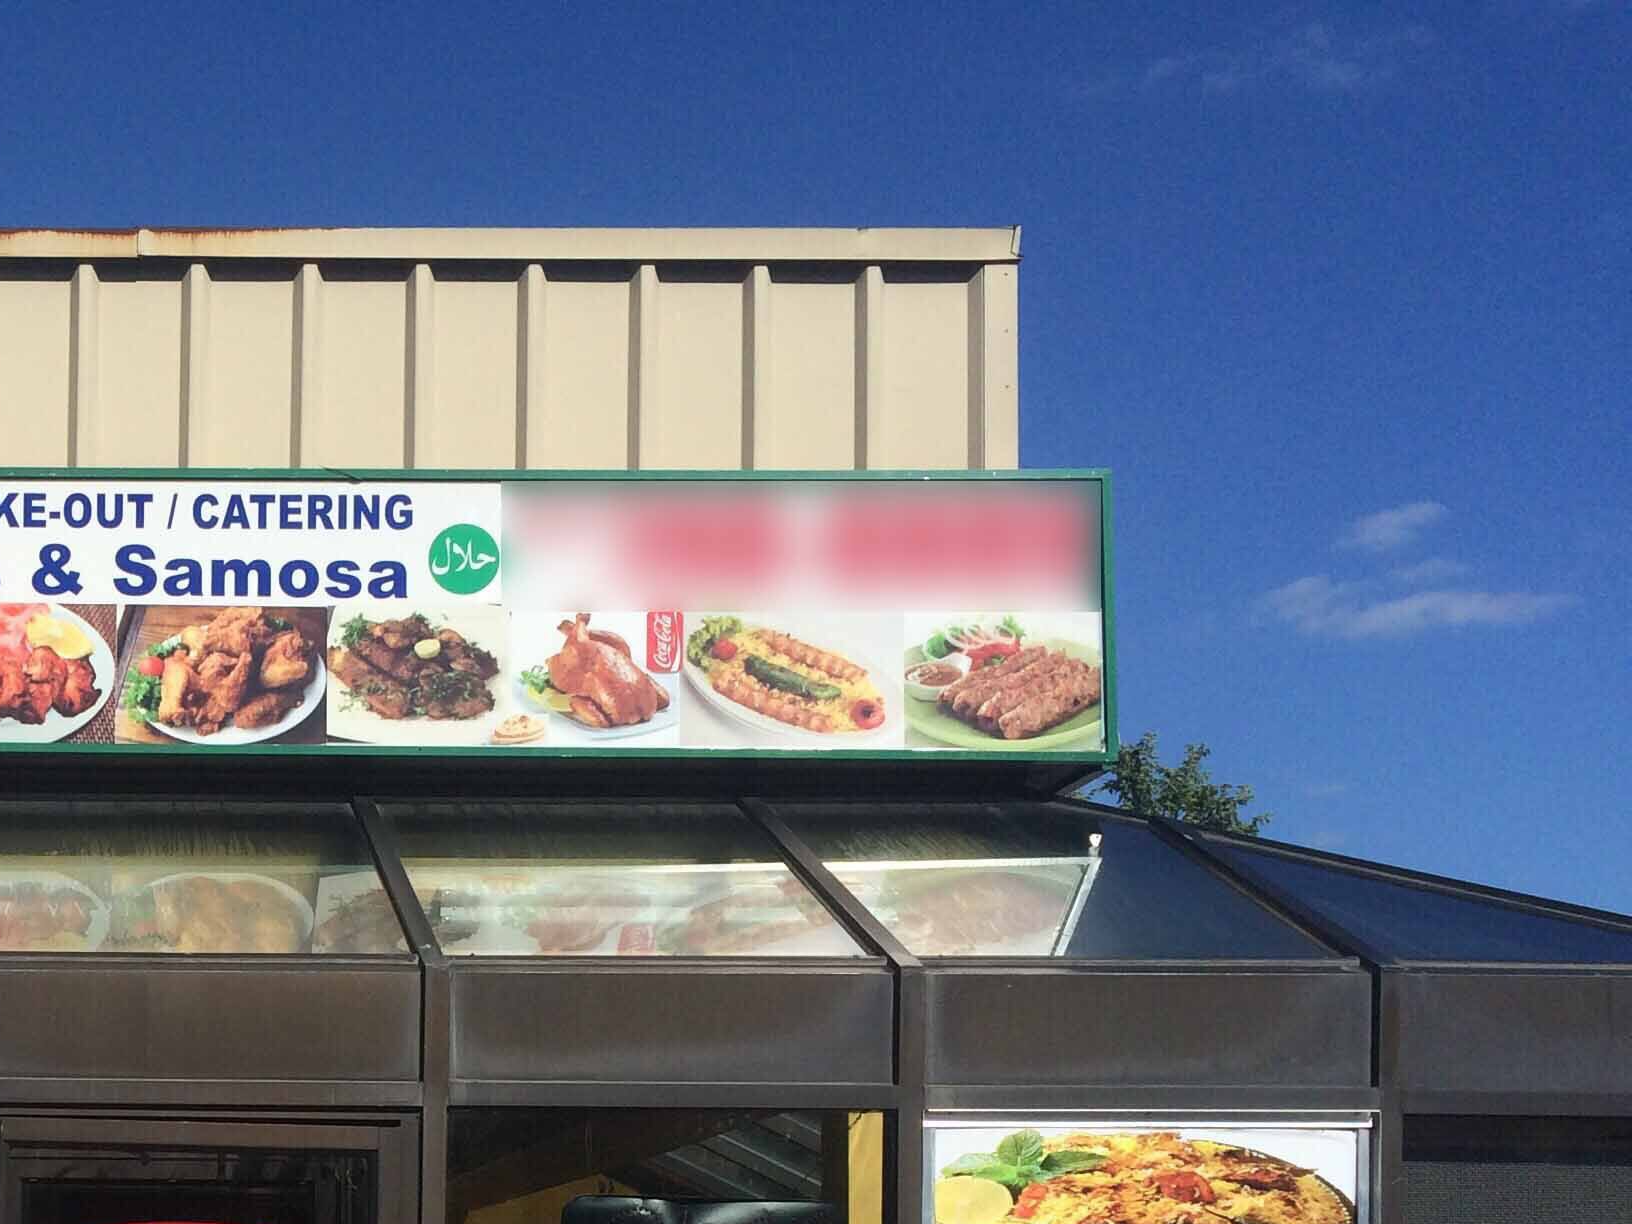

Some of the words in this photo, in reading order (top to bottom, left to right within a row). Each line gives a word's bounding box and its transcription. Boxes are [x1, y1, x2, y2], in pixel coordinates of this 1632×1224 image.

[192, 494, 414, 530] CATERING
[31, 543, 82, 596] &
[114, 543, 408, 598] Samosa
